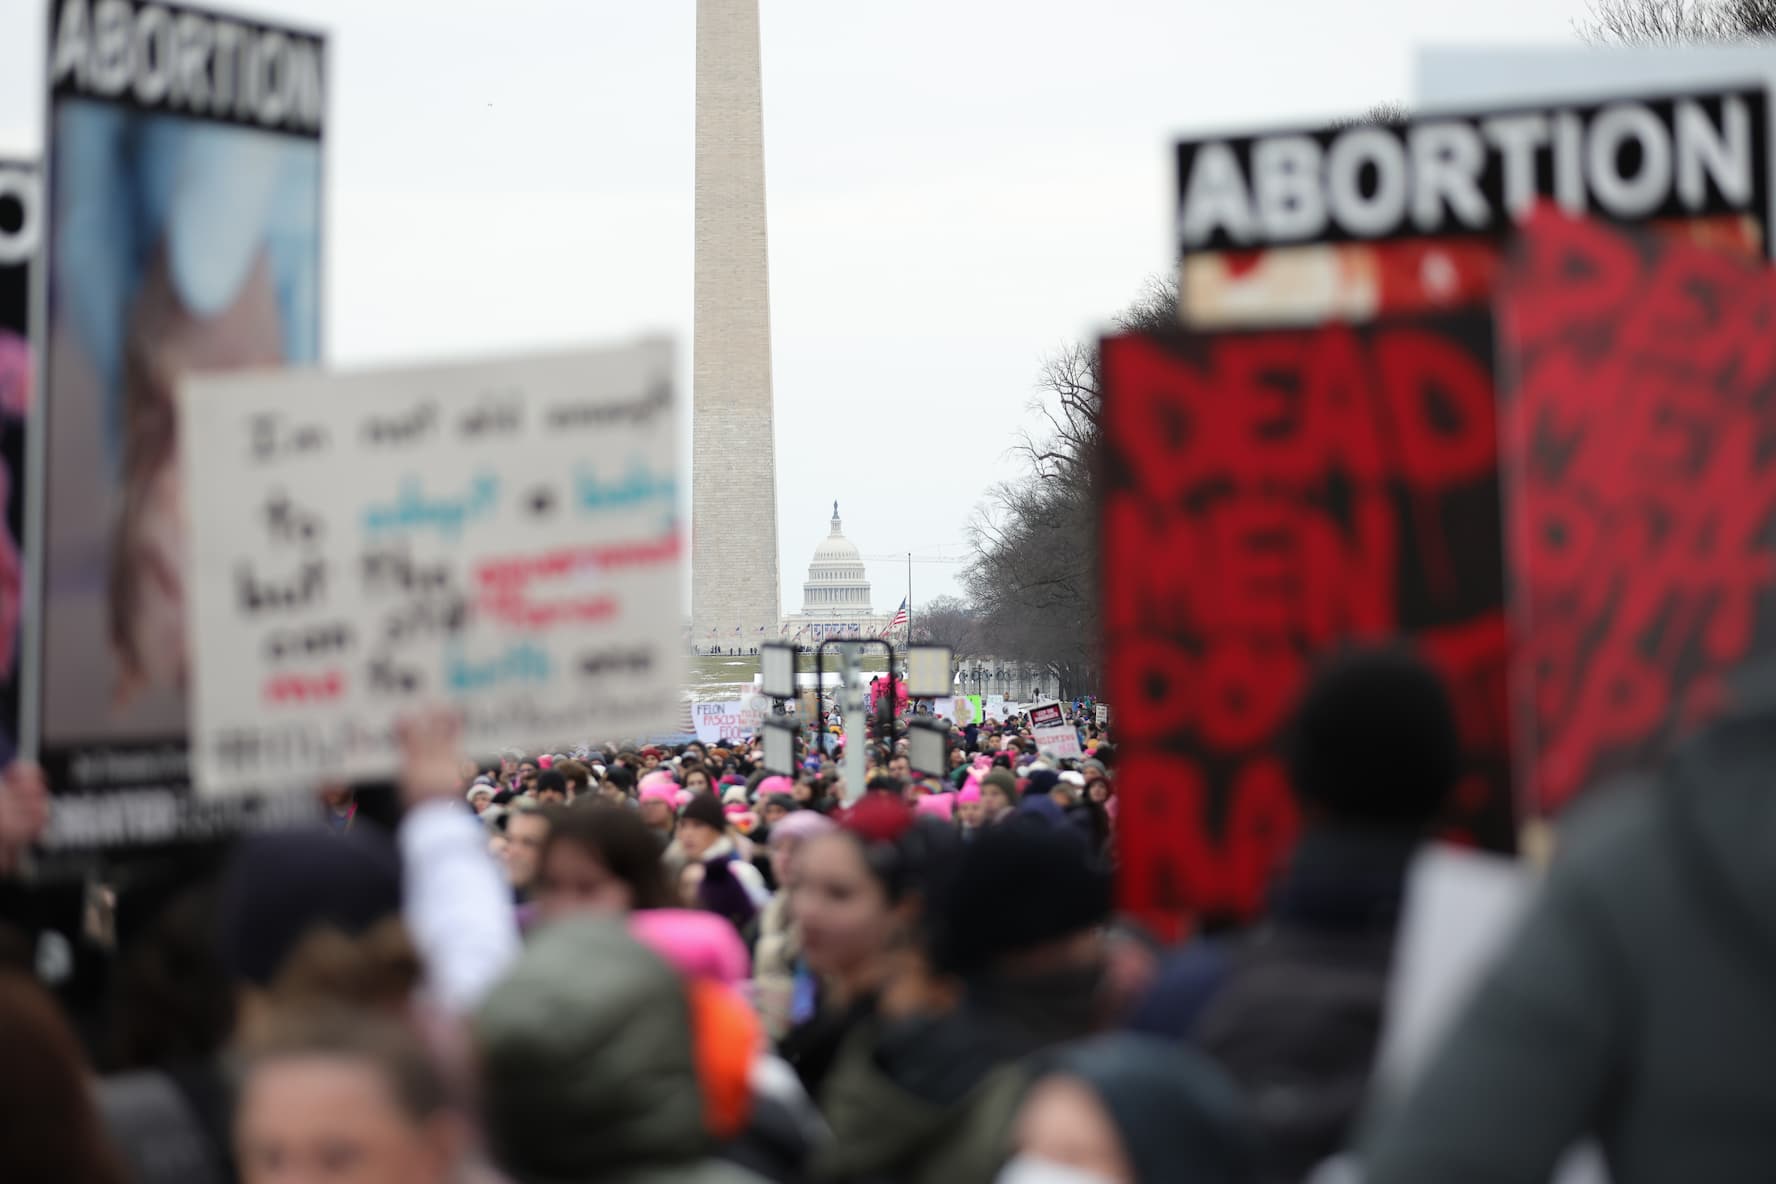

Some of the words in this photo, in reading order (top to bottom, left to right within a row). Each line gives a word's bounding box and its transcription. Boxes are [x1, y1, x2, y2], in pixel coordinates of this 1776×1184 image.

[52, 0, 323, 127] ABORTION
[1178, 95, 1754, 246] ABORTION
[358, 402, 437, 446] not
[1104, 322, 1503, 494] DEAD
[263, 485, 321, 547] to
[361, 470, 501, 540] adopt
[524, 484, 557, 519] a
[234, 555, 326, 614] but
[1105, 492, 1399, 642] MEN
[263, 622, 352, 661] can
[261, 668, 346, 706] me
[366, 655, 422, 696] to
[697, 703, 726, 715] FELON
